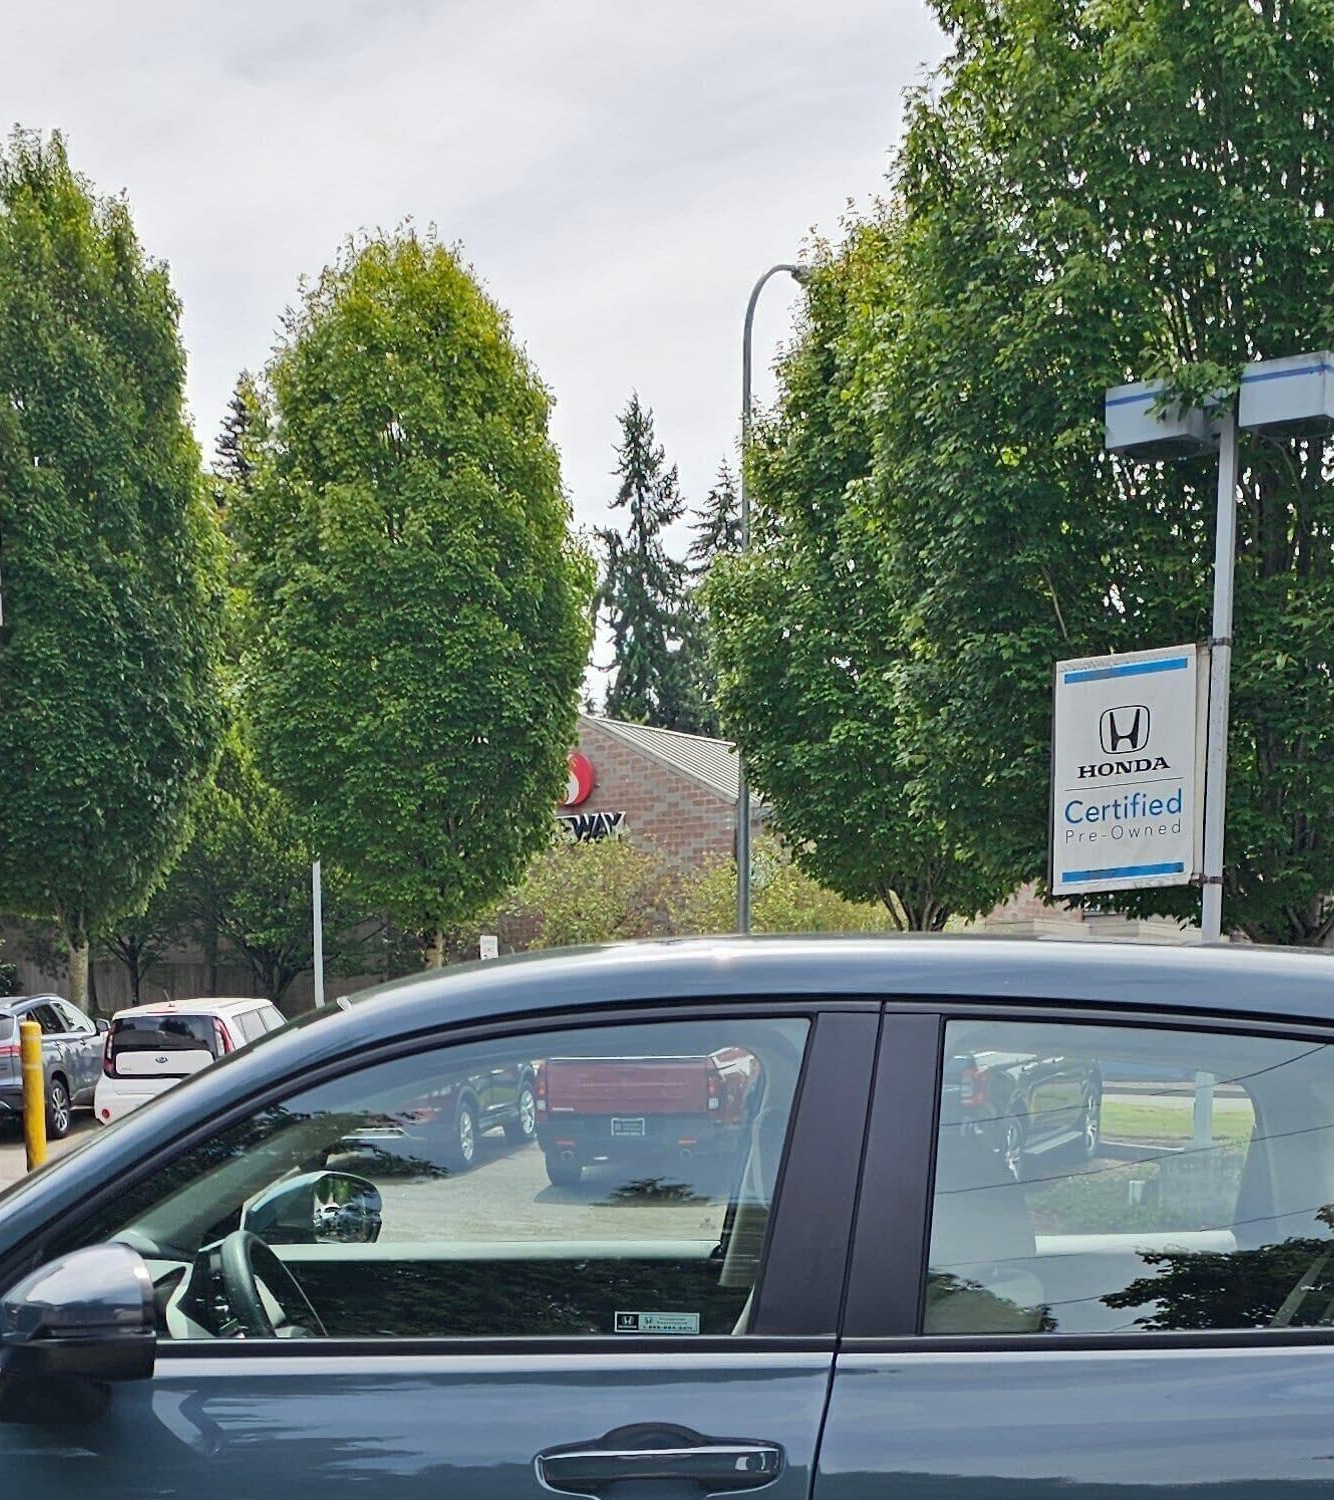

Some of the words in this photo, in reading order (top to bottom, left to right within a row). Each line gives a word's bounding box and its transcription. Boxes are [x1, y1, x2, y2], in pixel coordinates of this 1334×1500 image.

[1077, 757, 1170, 778] HONDA
[1064, 788, 1182, 823] Certified
[1065, 819, 1182, 843] Pre-Owned
